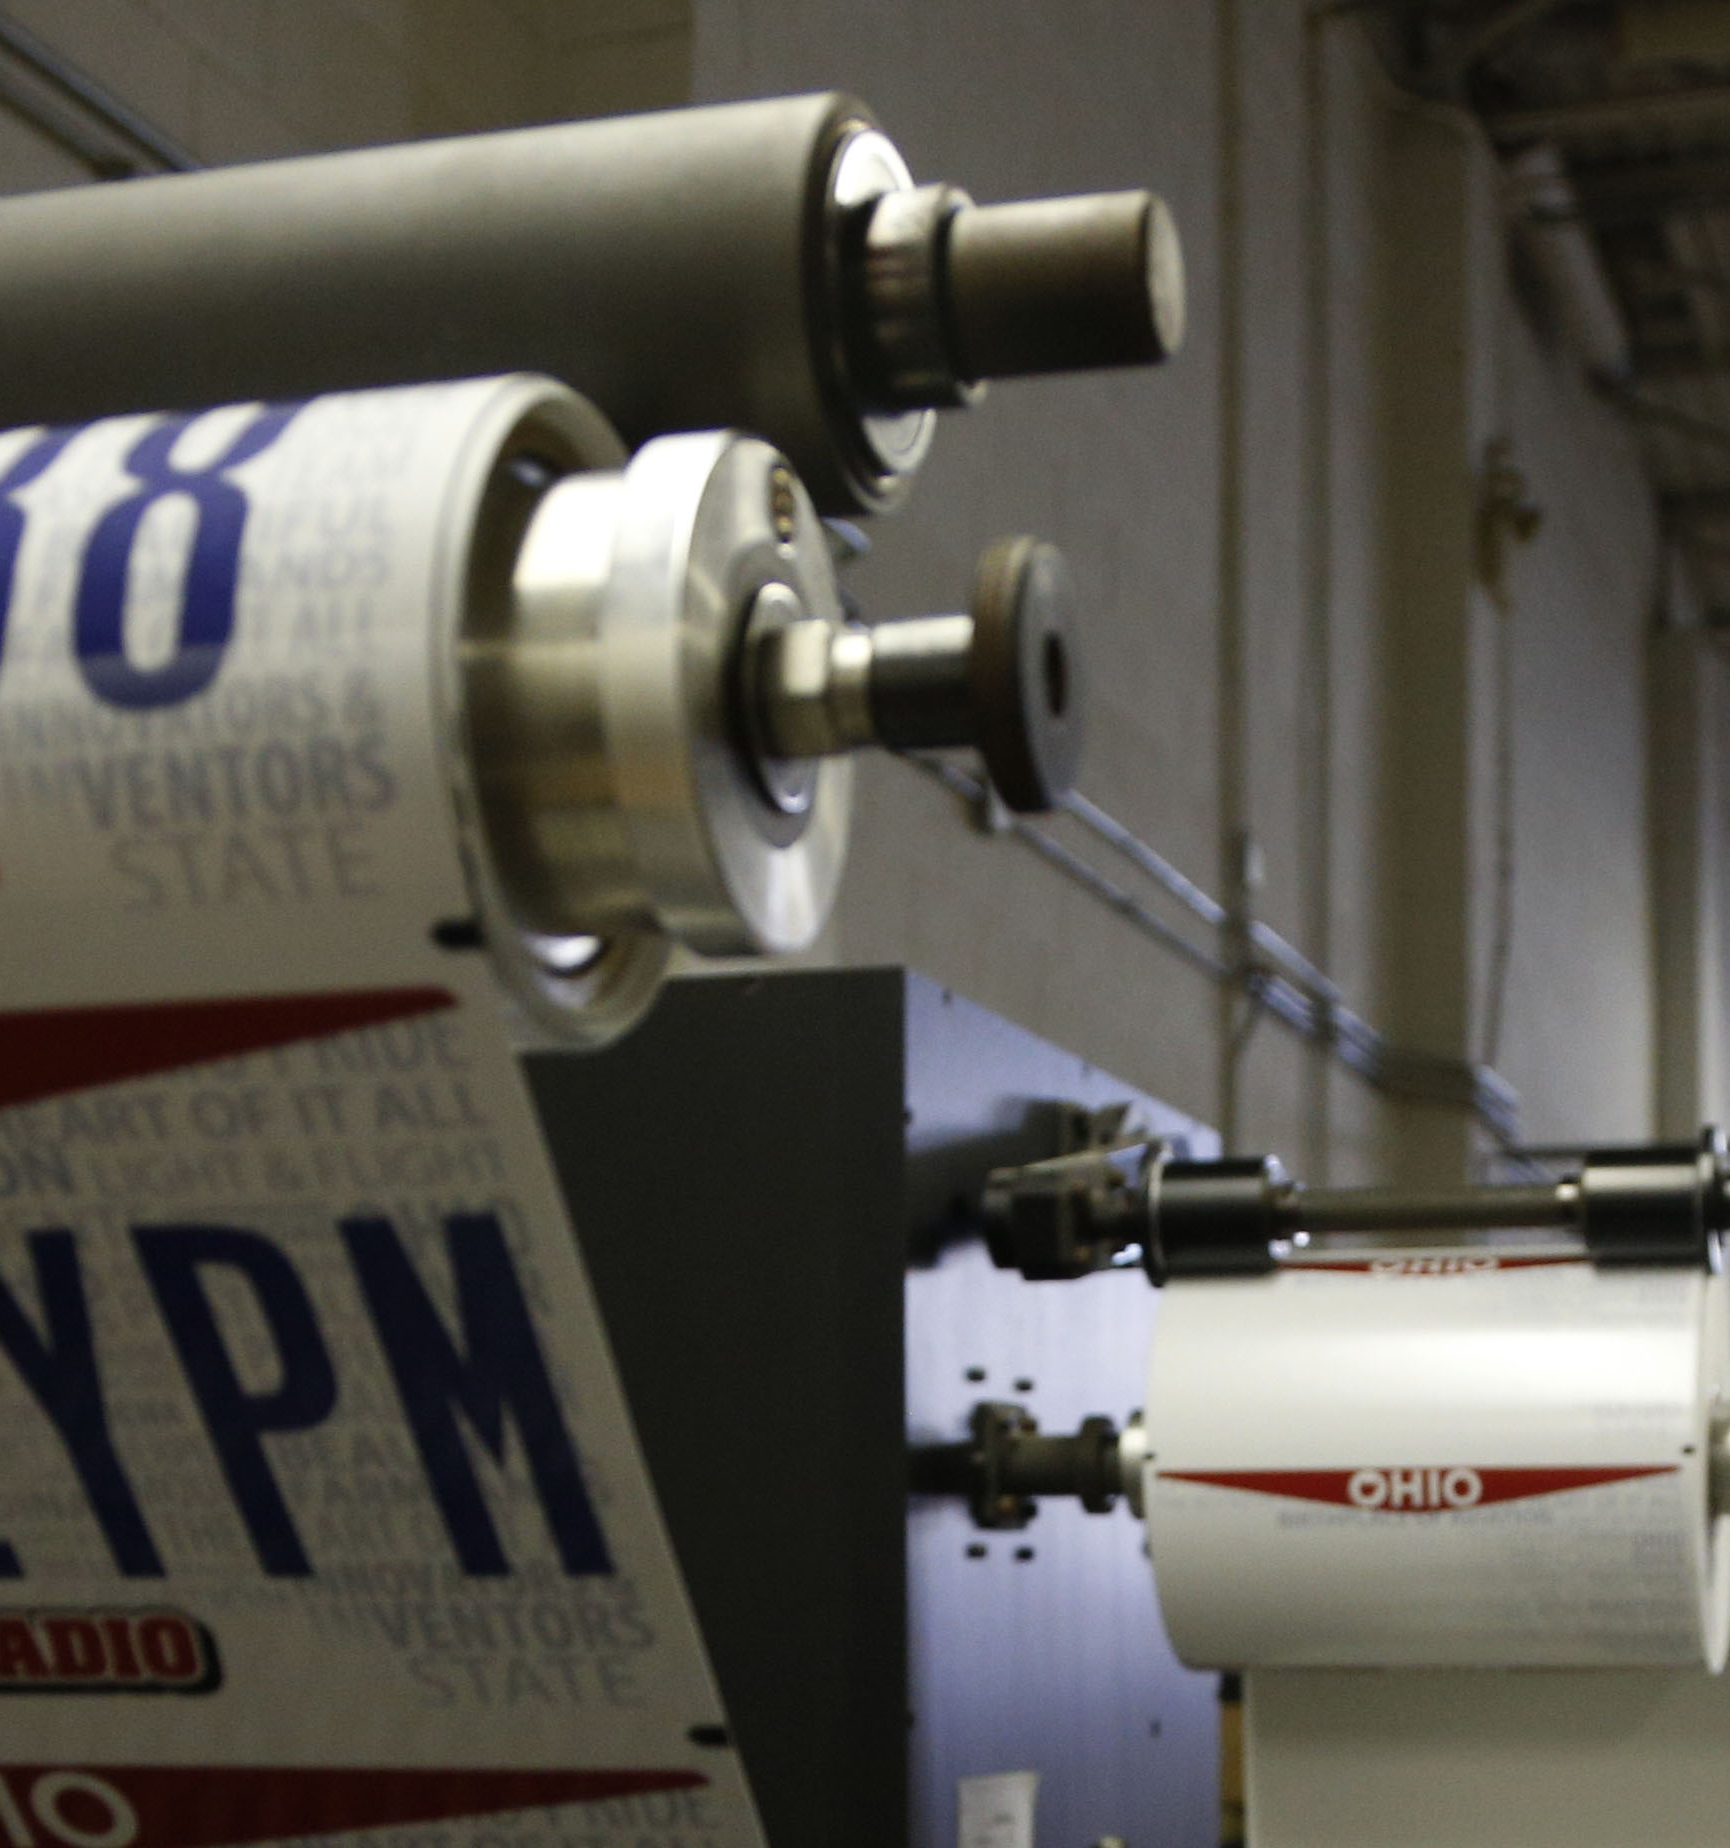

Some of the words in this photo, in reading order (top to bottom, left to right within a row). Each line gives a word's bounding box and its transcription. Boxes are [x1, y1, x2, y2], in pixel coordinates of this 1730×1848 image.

[108, 816, 380, 916] STATE
[184, 1089, 280, 1137] OF
[294, 1087, 357, 1130] IT
[367, 1080, 486, 1128] ALL
[1347, 1467, 1484, 1509] OHIO
[403, 1653, 643, 1706] STATE
